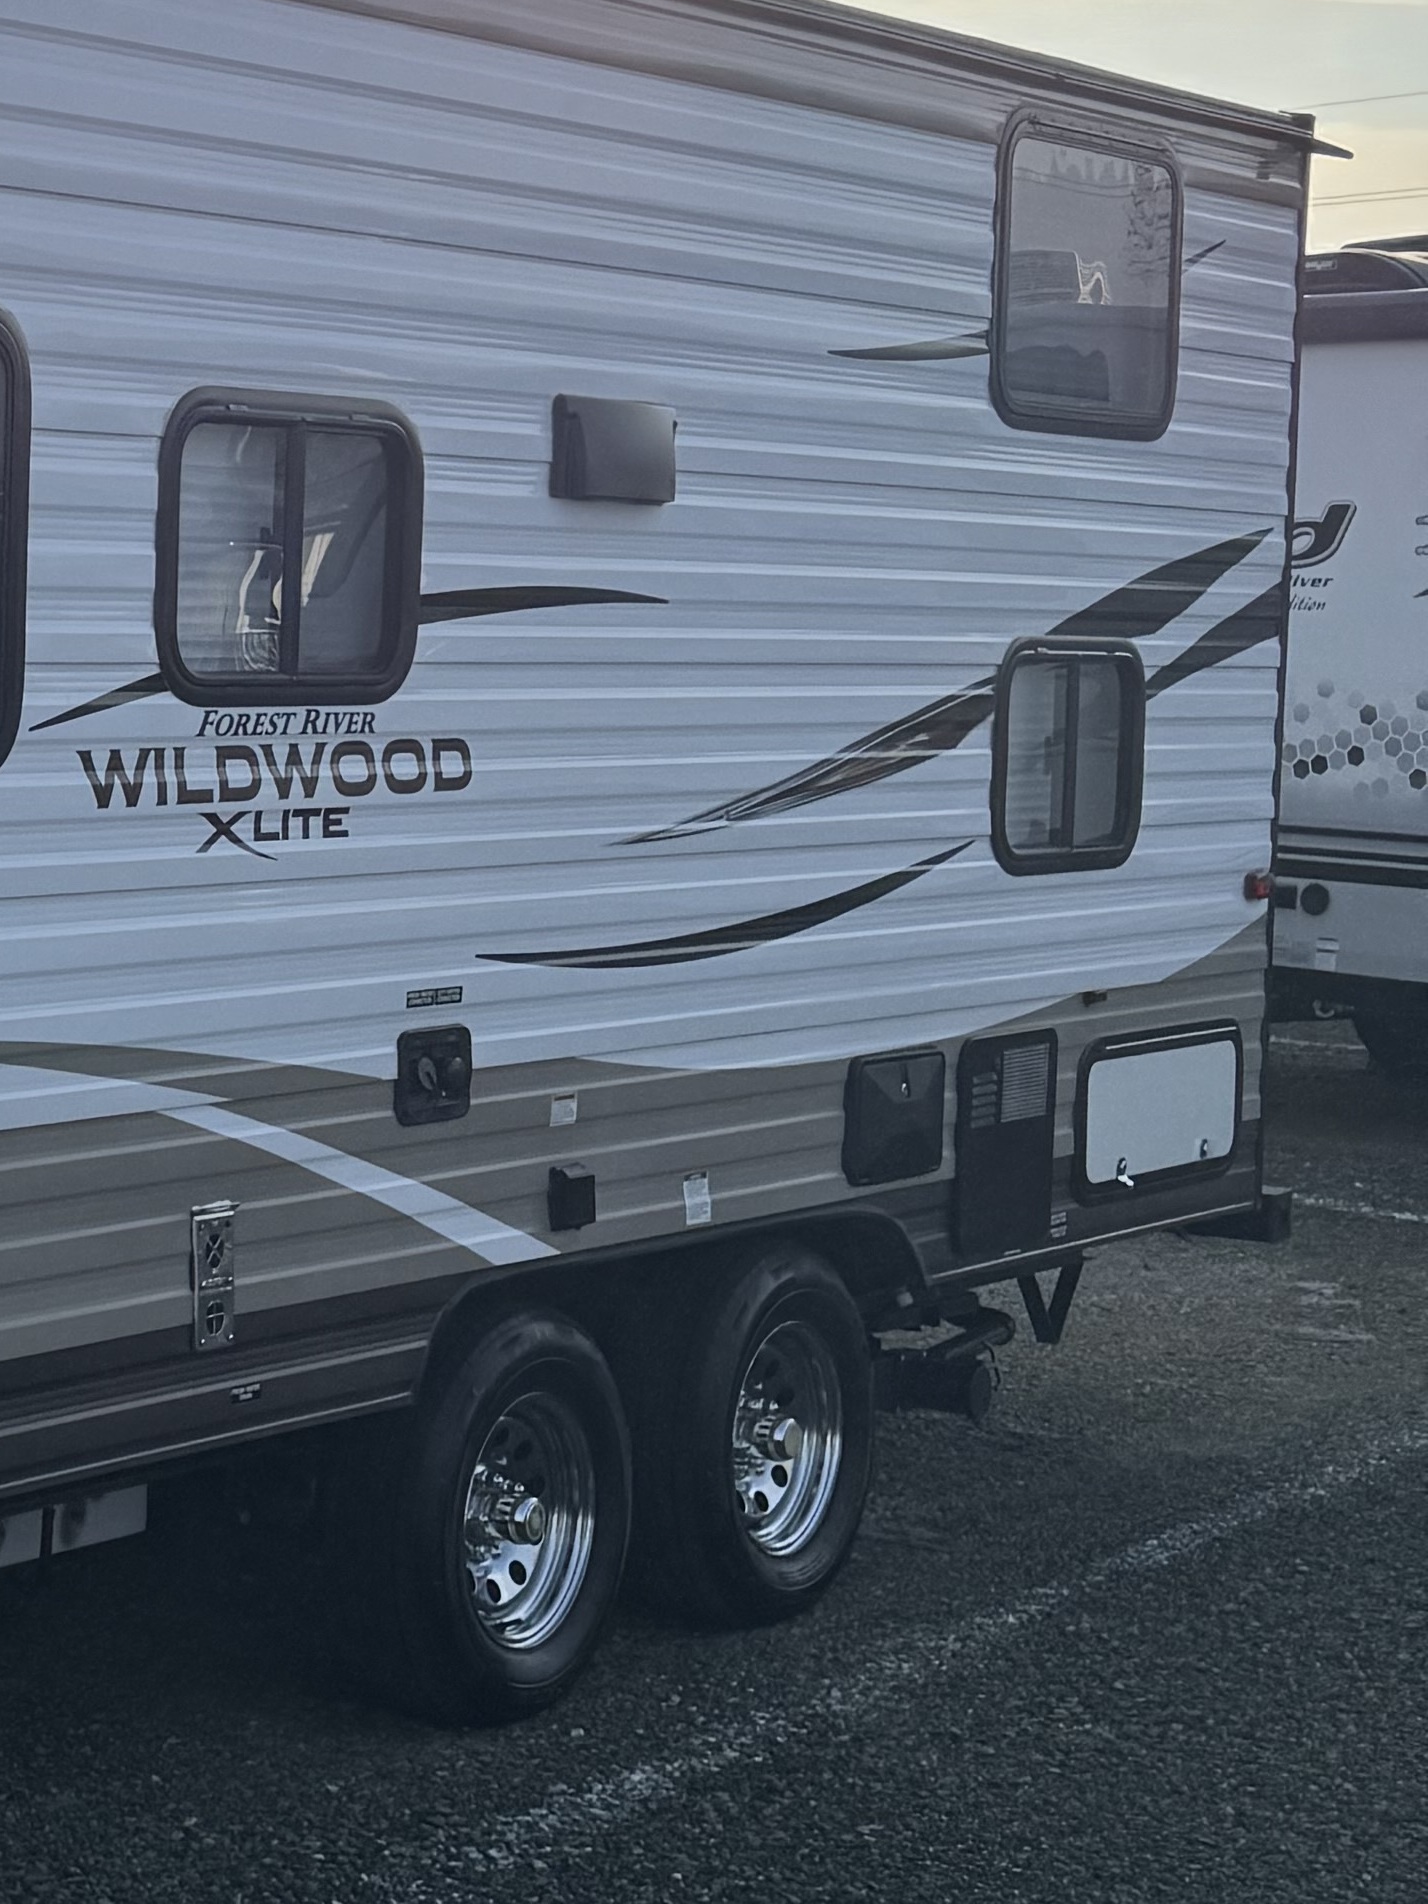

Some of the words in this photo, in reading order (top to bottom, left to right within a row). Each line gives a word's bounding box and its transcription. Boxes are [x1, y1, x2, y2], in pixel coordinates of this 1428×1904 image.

[194, 709, 297, 738] FOREST
[299, 708, 377, 736] RIVER
[76, 737, 473, 809] WILDWOOD
[194, 806, 351, 861] XLITE
